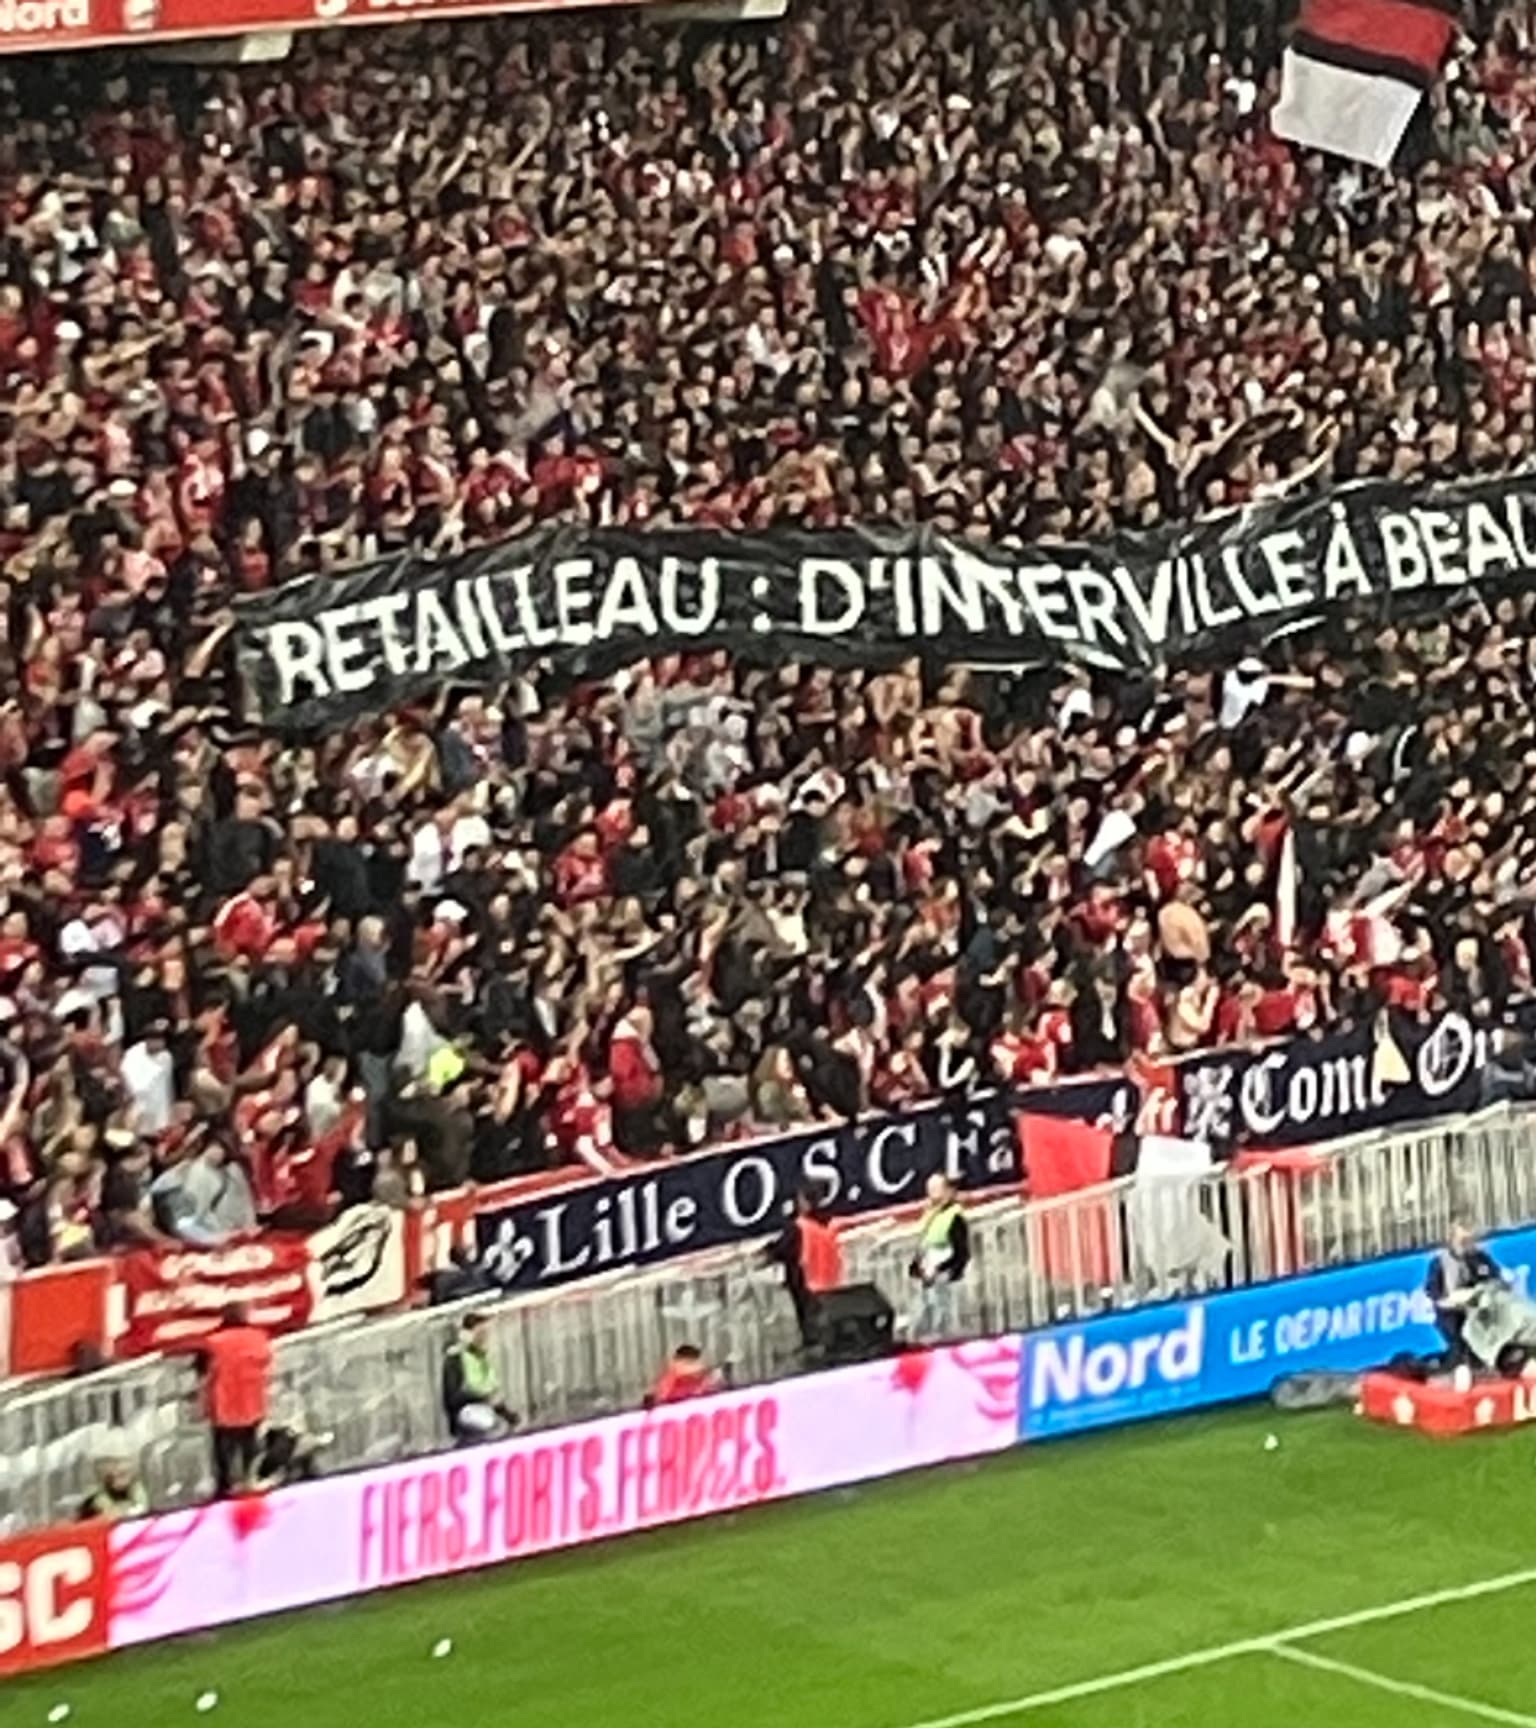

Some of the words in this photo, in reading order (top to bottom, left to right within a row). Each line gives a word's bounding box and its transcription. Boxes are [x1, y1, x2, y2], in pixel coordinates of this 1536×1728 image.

[0, 0, 90, 31] ord
[260, 556, 720, 704] RETAILLEAU
[536, 1181, 697, 1279] Lille
[1030, 1304, 1206, 1409] Nord
[1230, 1320, 1268, 1364] LE
